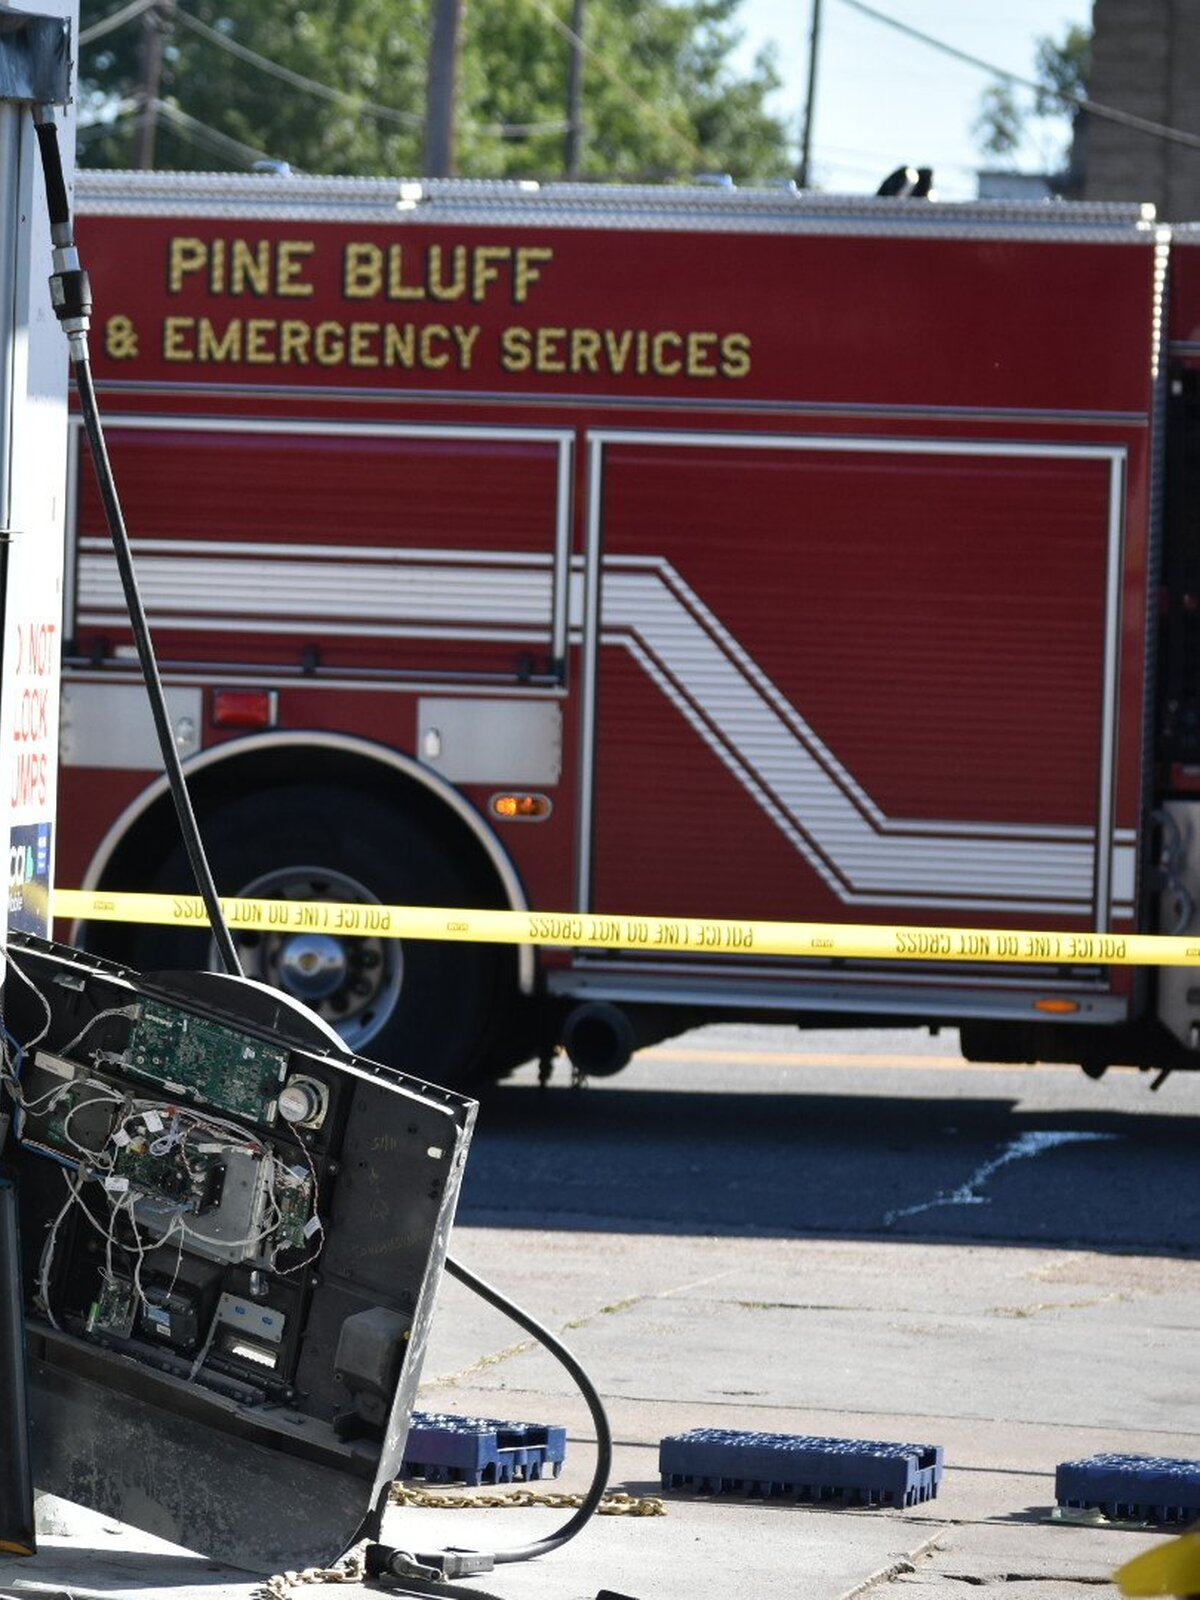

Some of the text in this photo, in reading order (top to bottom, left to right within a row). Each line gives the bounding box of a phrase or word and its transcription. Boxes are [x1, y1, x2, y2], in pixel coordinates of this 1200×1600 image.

[168, 236, 553, 301] PINE BLUFF
[106, 315, 751, 377] & EMERGENCY SERVICES
[13, 688, 49, 742] LOCK
[11, 753, 48, 808] UMPS
[173, 898, 391, 930] POLICE LINE DO NOT OSS
[529, 917, 754, 947] POLICE LINE DO NOT CROSS
[895, 932, 1127, 958] POLICE LINE DO NOT CROSS
